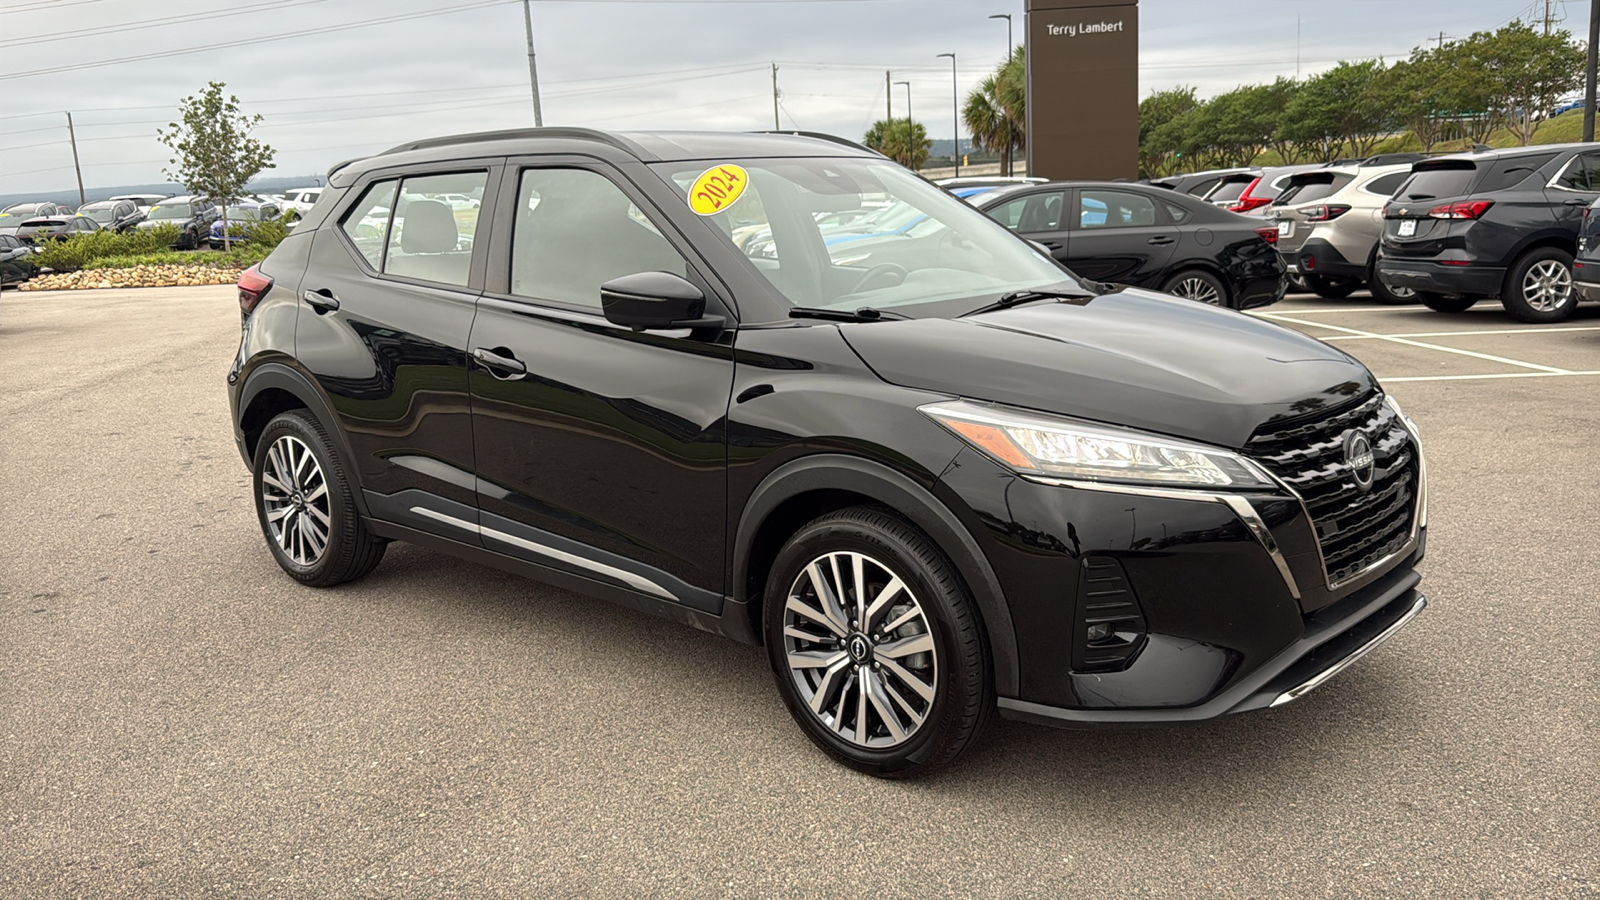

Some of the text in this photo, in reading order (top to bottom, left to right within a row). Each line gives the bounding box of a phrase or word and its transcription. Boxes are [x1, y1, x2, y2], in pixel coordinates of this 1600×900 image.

[1047, 20, 1123, 37] Terry Lambert
[697, 168, 740, 209] 2024
[1348, 453, 1374, 469] NISSAN
